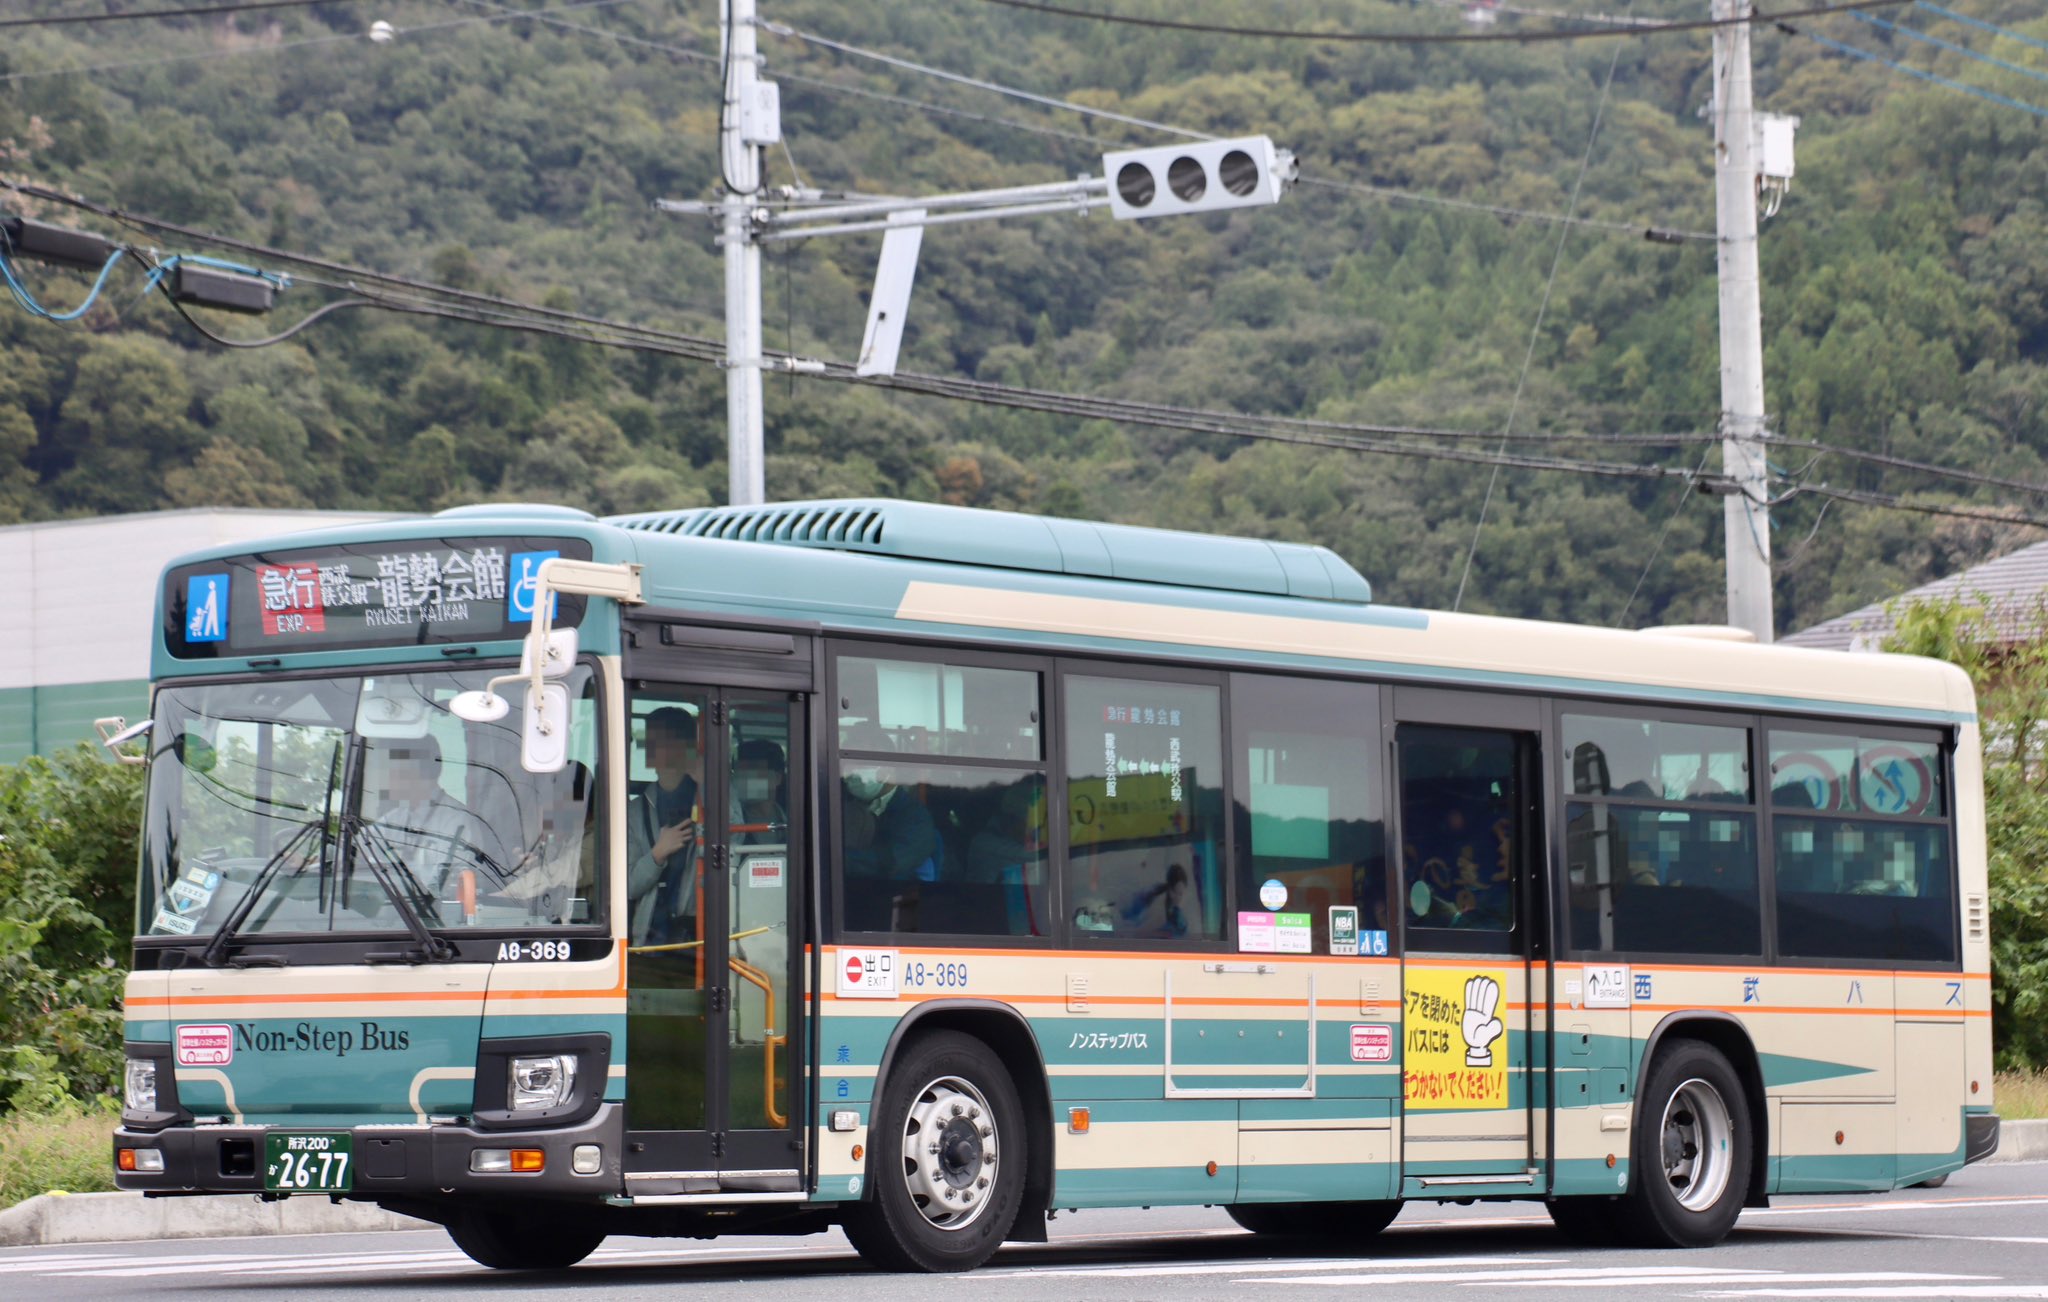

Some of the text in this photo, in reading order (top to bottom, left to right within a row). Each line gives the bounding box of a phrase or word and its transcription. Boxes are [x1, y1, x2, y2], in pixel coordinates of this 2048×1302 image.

[319, 565, 350, 586] 西武
[377, 548, 505, 608] 龍勢会館
[261, 568, 315, 610] 急行
[276, 613, 311, 632] EXP.
[365, 602, 469, 627] RYUSEI KAIKAN
[1334, 916, 1352, 930] NBA
[497, 941, 571, 961] A8-369
[864, 954, 891, 972] 出口
[867, 976, 888, 987] EXIT
[904, 962, 968, 987] A8-369
[1602, 970, 1622, 986] 入口
[235, 1021, 409, 1057] Non-Step Bus
[1069, 1032, 1148, 1049] ノンステップバス
[1408, 1027, 1449, 1053] バスには
[837, 1045, 850, 1097] 乗合
[288, 1136, 329, 1150] 所沢200
[279, 1152, 348, 1188] 26-77
